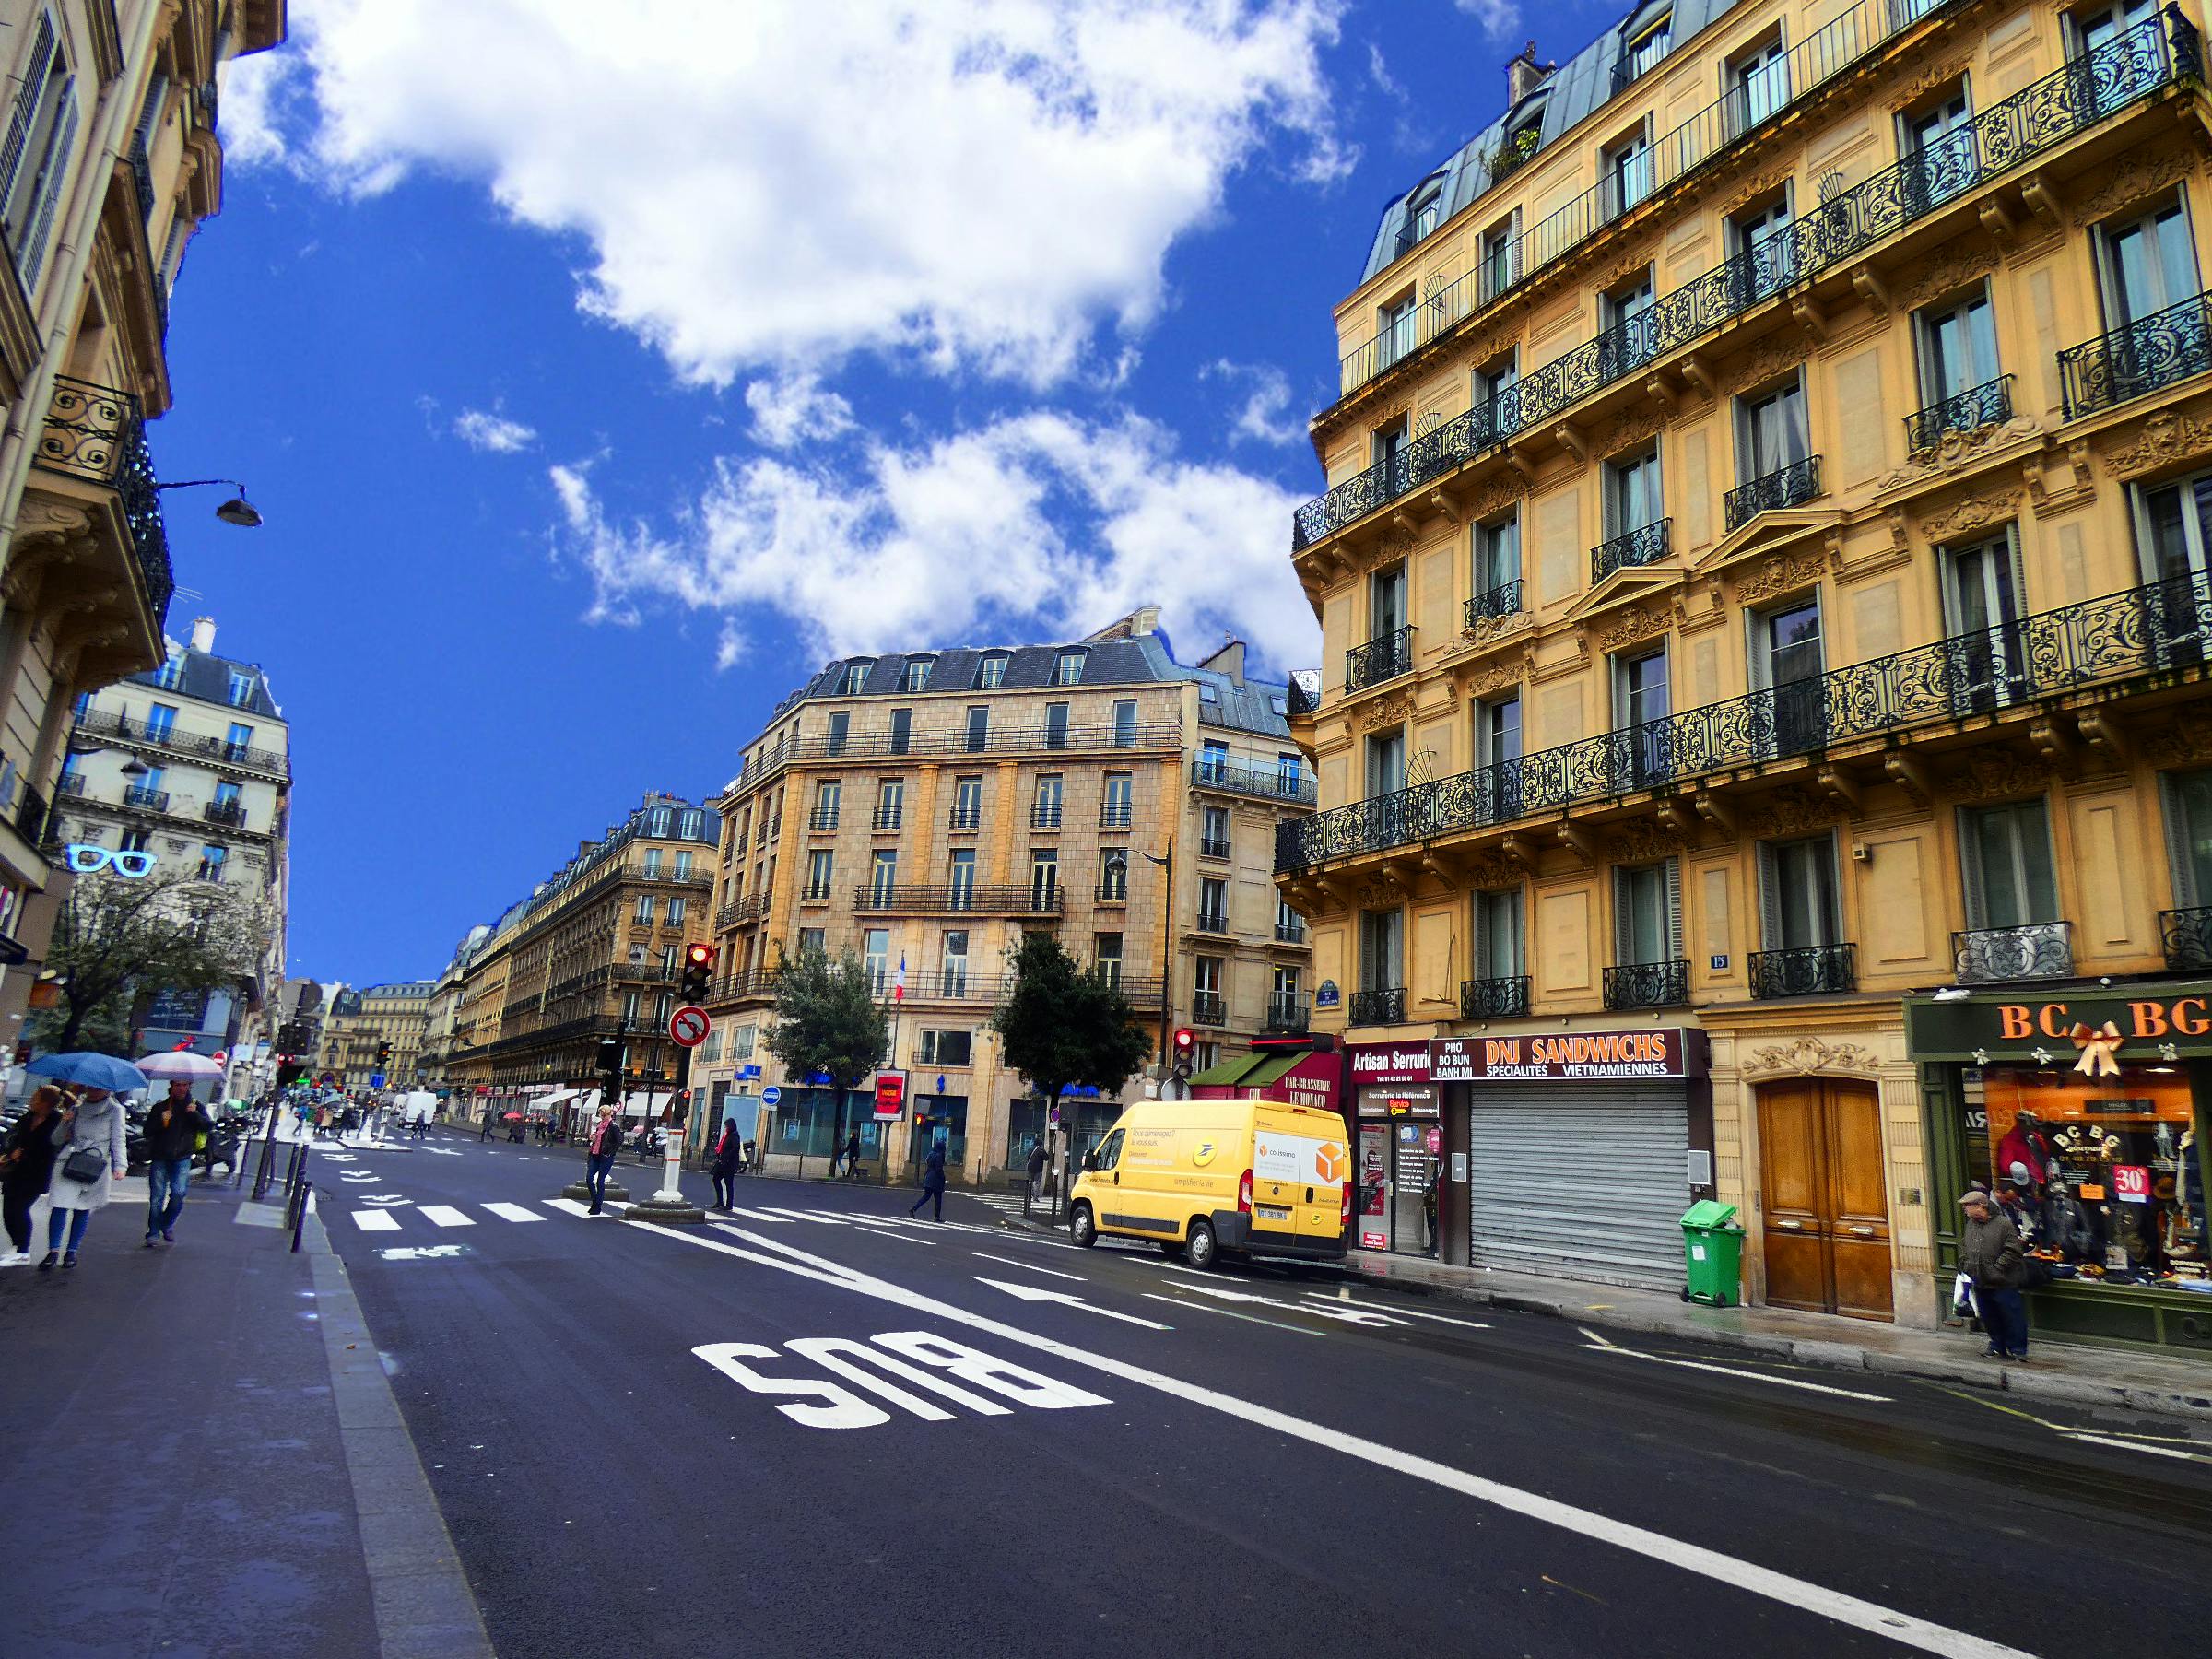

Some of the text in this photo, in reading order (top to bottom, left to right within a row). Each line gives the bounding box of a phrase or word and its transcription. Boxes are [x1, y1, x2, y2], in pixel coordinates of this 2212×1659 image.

[1714, 956, 1725, 968] 15
[1997, 998, 2212, 1039] BC BG
[1486, 1033, 1667, 1065] DNJ SANDWICHS
[1353, 1052, 1389, 1071] Artisan
[1439, 1054, 1470, 1065] BO BUN
[1436, 1066, 1473, 1077] BANH MI
[1486, 1062, 1668, 1077] SPECIALITES VIETNAMIENNES
[1285, 1076, 1331, 1092] BAR-BRASSERIE
[1289, 1090, 1326, 1108] LE MONACO
[1389, 1100, 1410, 1108] Service
[1269, 1148, 1296, 1159] colissimo
[691, 1331, 1114, 1429] BUS
